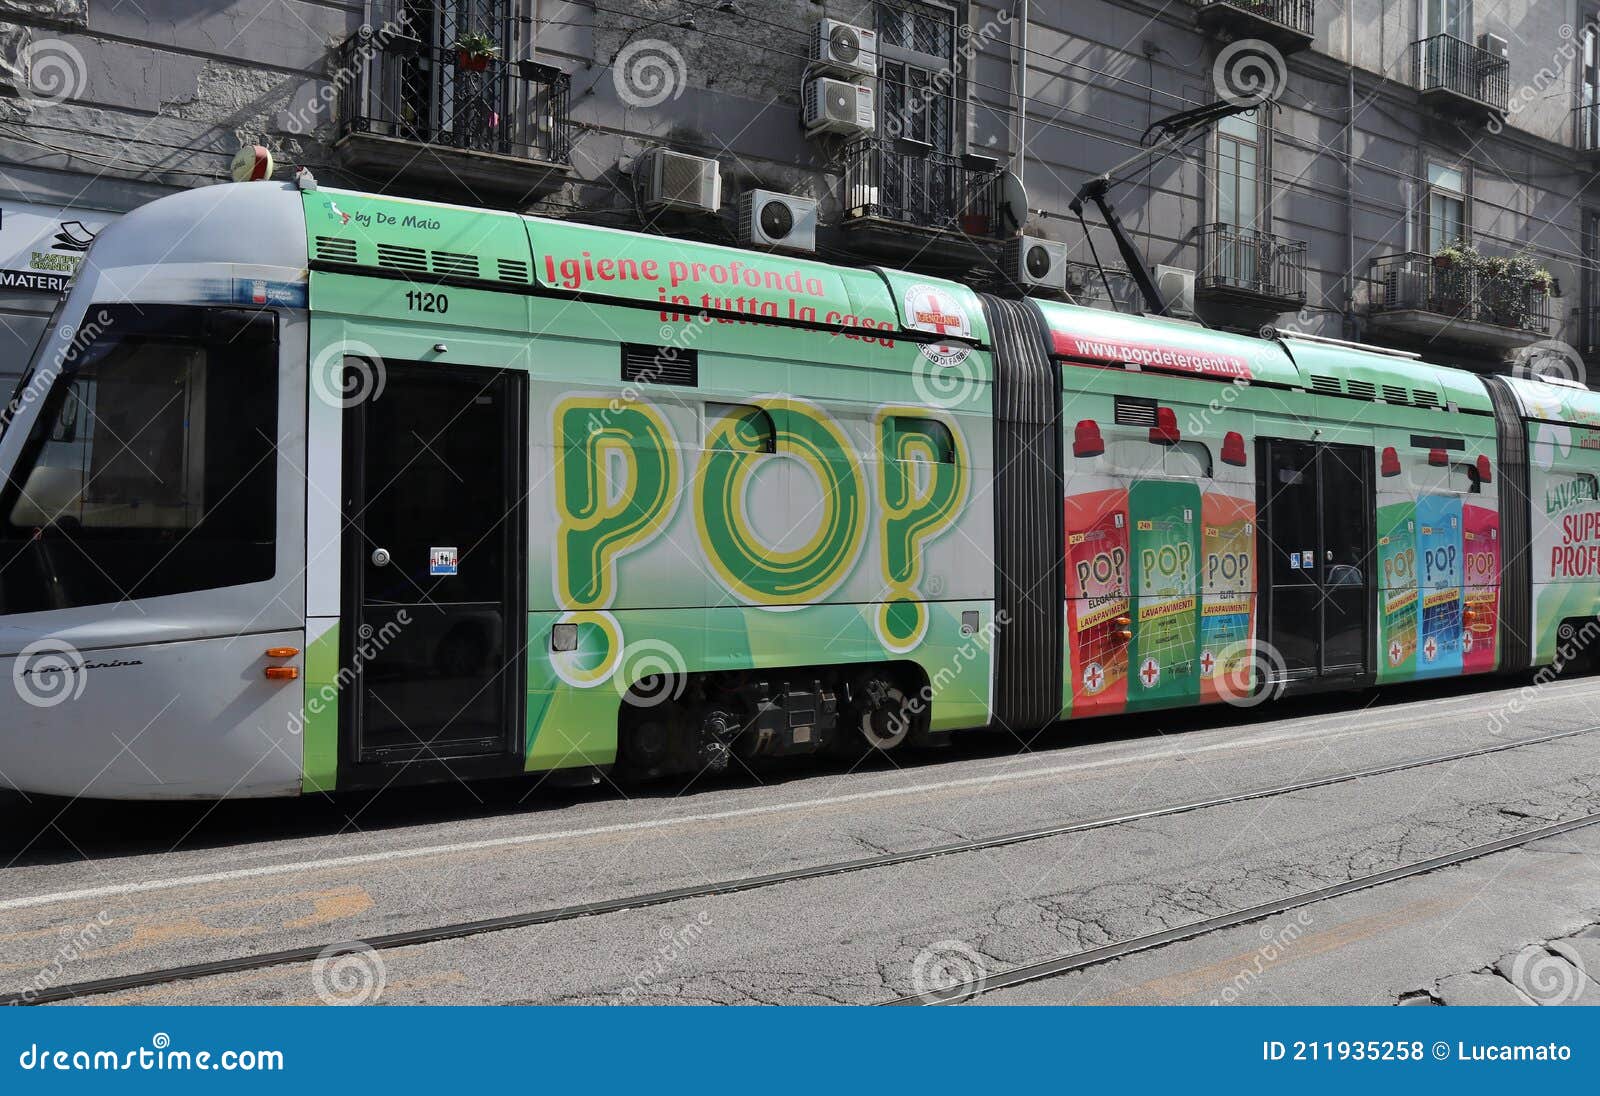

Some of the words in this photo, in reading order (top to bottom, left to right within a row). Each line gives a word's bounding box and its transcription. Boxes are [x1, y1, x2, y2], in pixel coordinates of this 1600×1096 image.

[355, 211, 371, 227] by
[376, 212, 397, 225] De
[402, 215, 441, 230] Maio
[544, 251, 659, 290] Igiene
[668, 260, 825, 297] profonda
[405, 289, 449, 314] 1120
[657, 287, 692, 323] in
[700, 292, 779, 327] tutta
[788, 298, 817, 333] la
[825, 308, 896, 349] casa
[1075, 338, 1245, 374] www.popdetergenti.it
[549, 394, 970, 687] POP
[1077, 547, 1126, 599] POP
[1143, 542, 1192, 589] POP
[1208, 553, 1249, 589] POP
[1425, 545, 1456, 581] POP
[1466, 552, 1494, 581] POP
[1088, 588, 1122, 609] ELEGANCE
[1141, 600, 1193, 618] LAVAPAVIMENTI
[1203, 603, 1248, 614] LAVAPAVIMENTI
